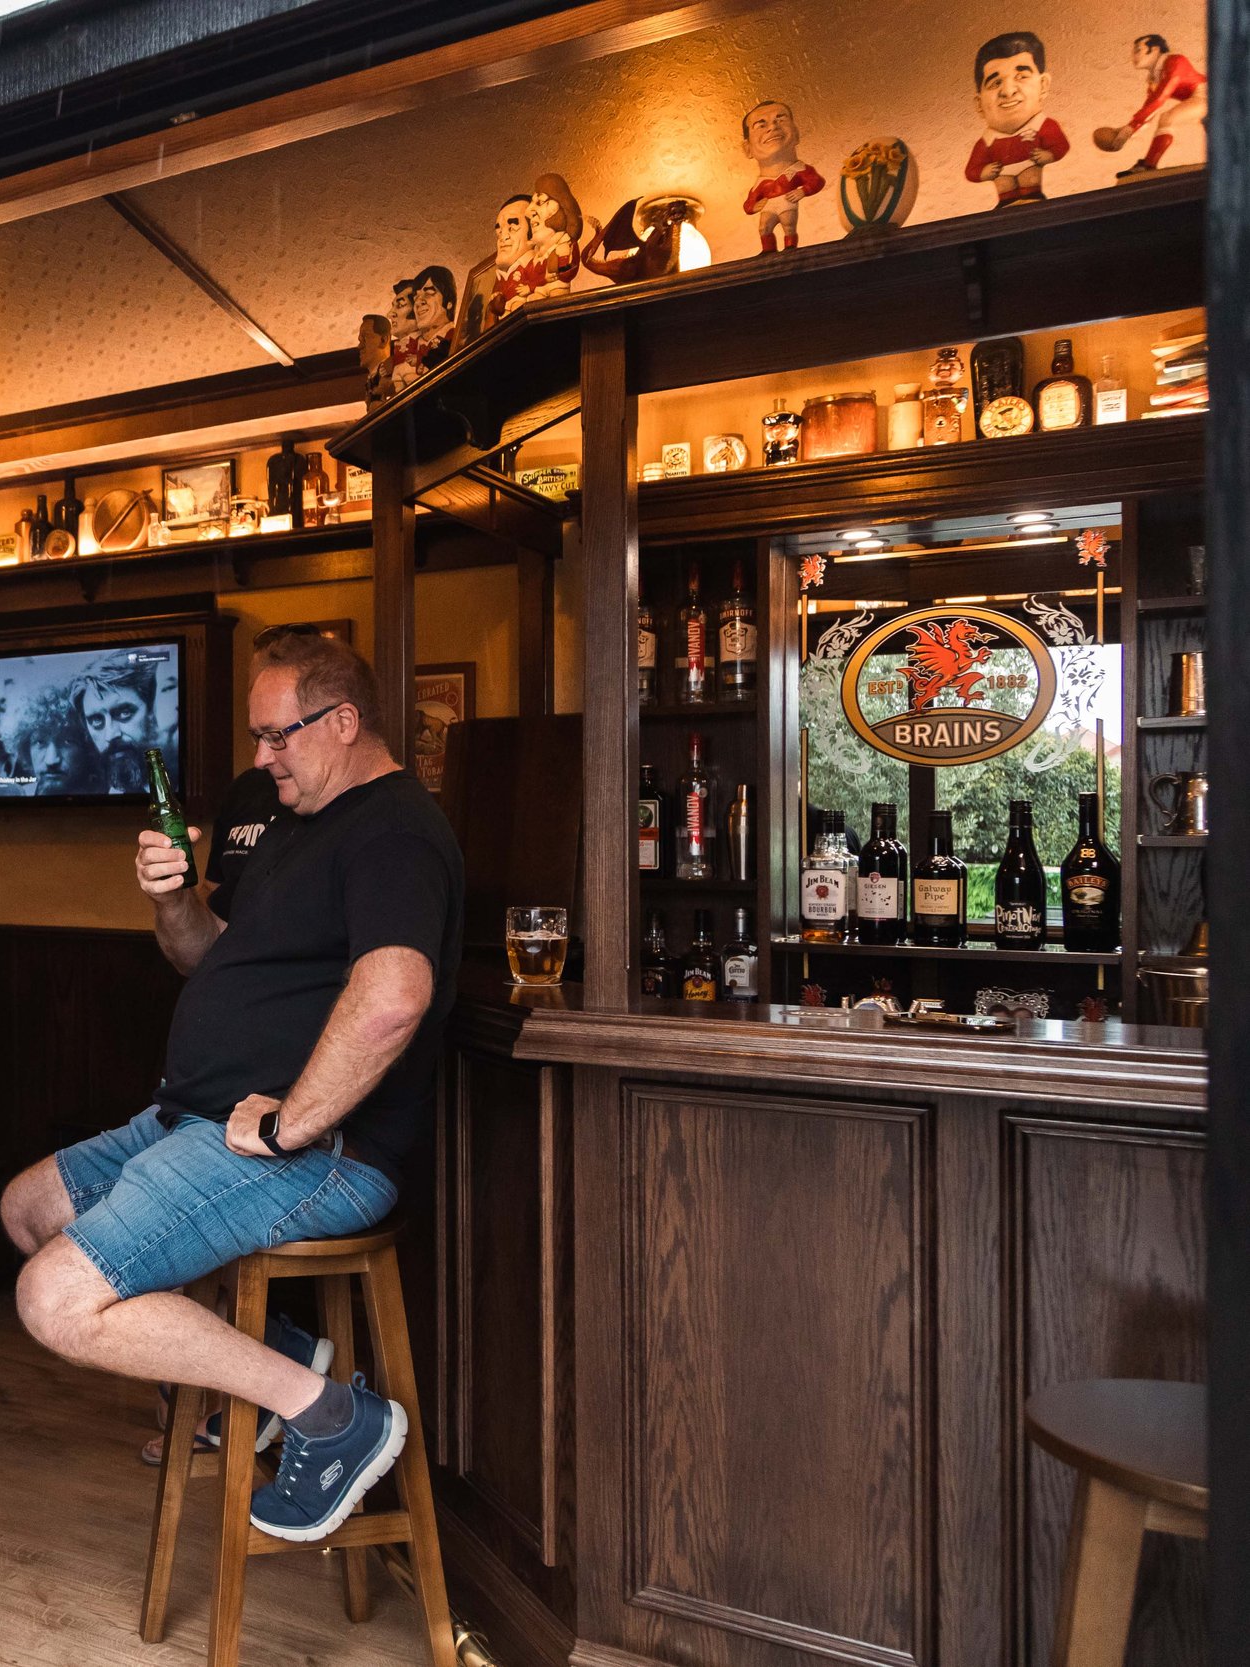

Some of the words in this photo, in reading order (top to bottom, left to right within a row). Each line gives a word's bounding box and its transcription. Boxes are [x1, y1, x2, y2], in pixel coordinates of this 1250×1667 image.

[538, 483, 559, 492] NAVY
[560, 481, 575, 490] CUT
[687, 622, 701, 657] IVANOV
[987, 674, 1028, 690] 1882
[894, 720, 1002, 748] BRAINS
[420, 766, 444, 778] TOBA
[686, 795, 700, 831] IVANOV
[805, 876, 818, 888] JIM
[819, 874, 840, 889] BEAM
[1068, 877, 1107, 887] BAILEYS
[918, 884, 952, 896] Galway
[924, 892, 945, 901] Pipe
[995, 904, 1023, 926] Pinot
[683, 969, 695, 979] JIM
[694, 967, 712, 981] BEAM
[685, 989, 709, 998] Honey
